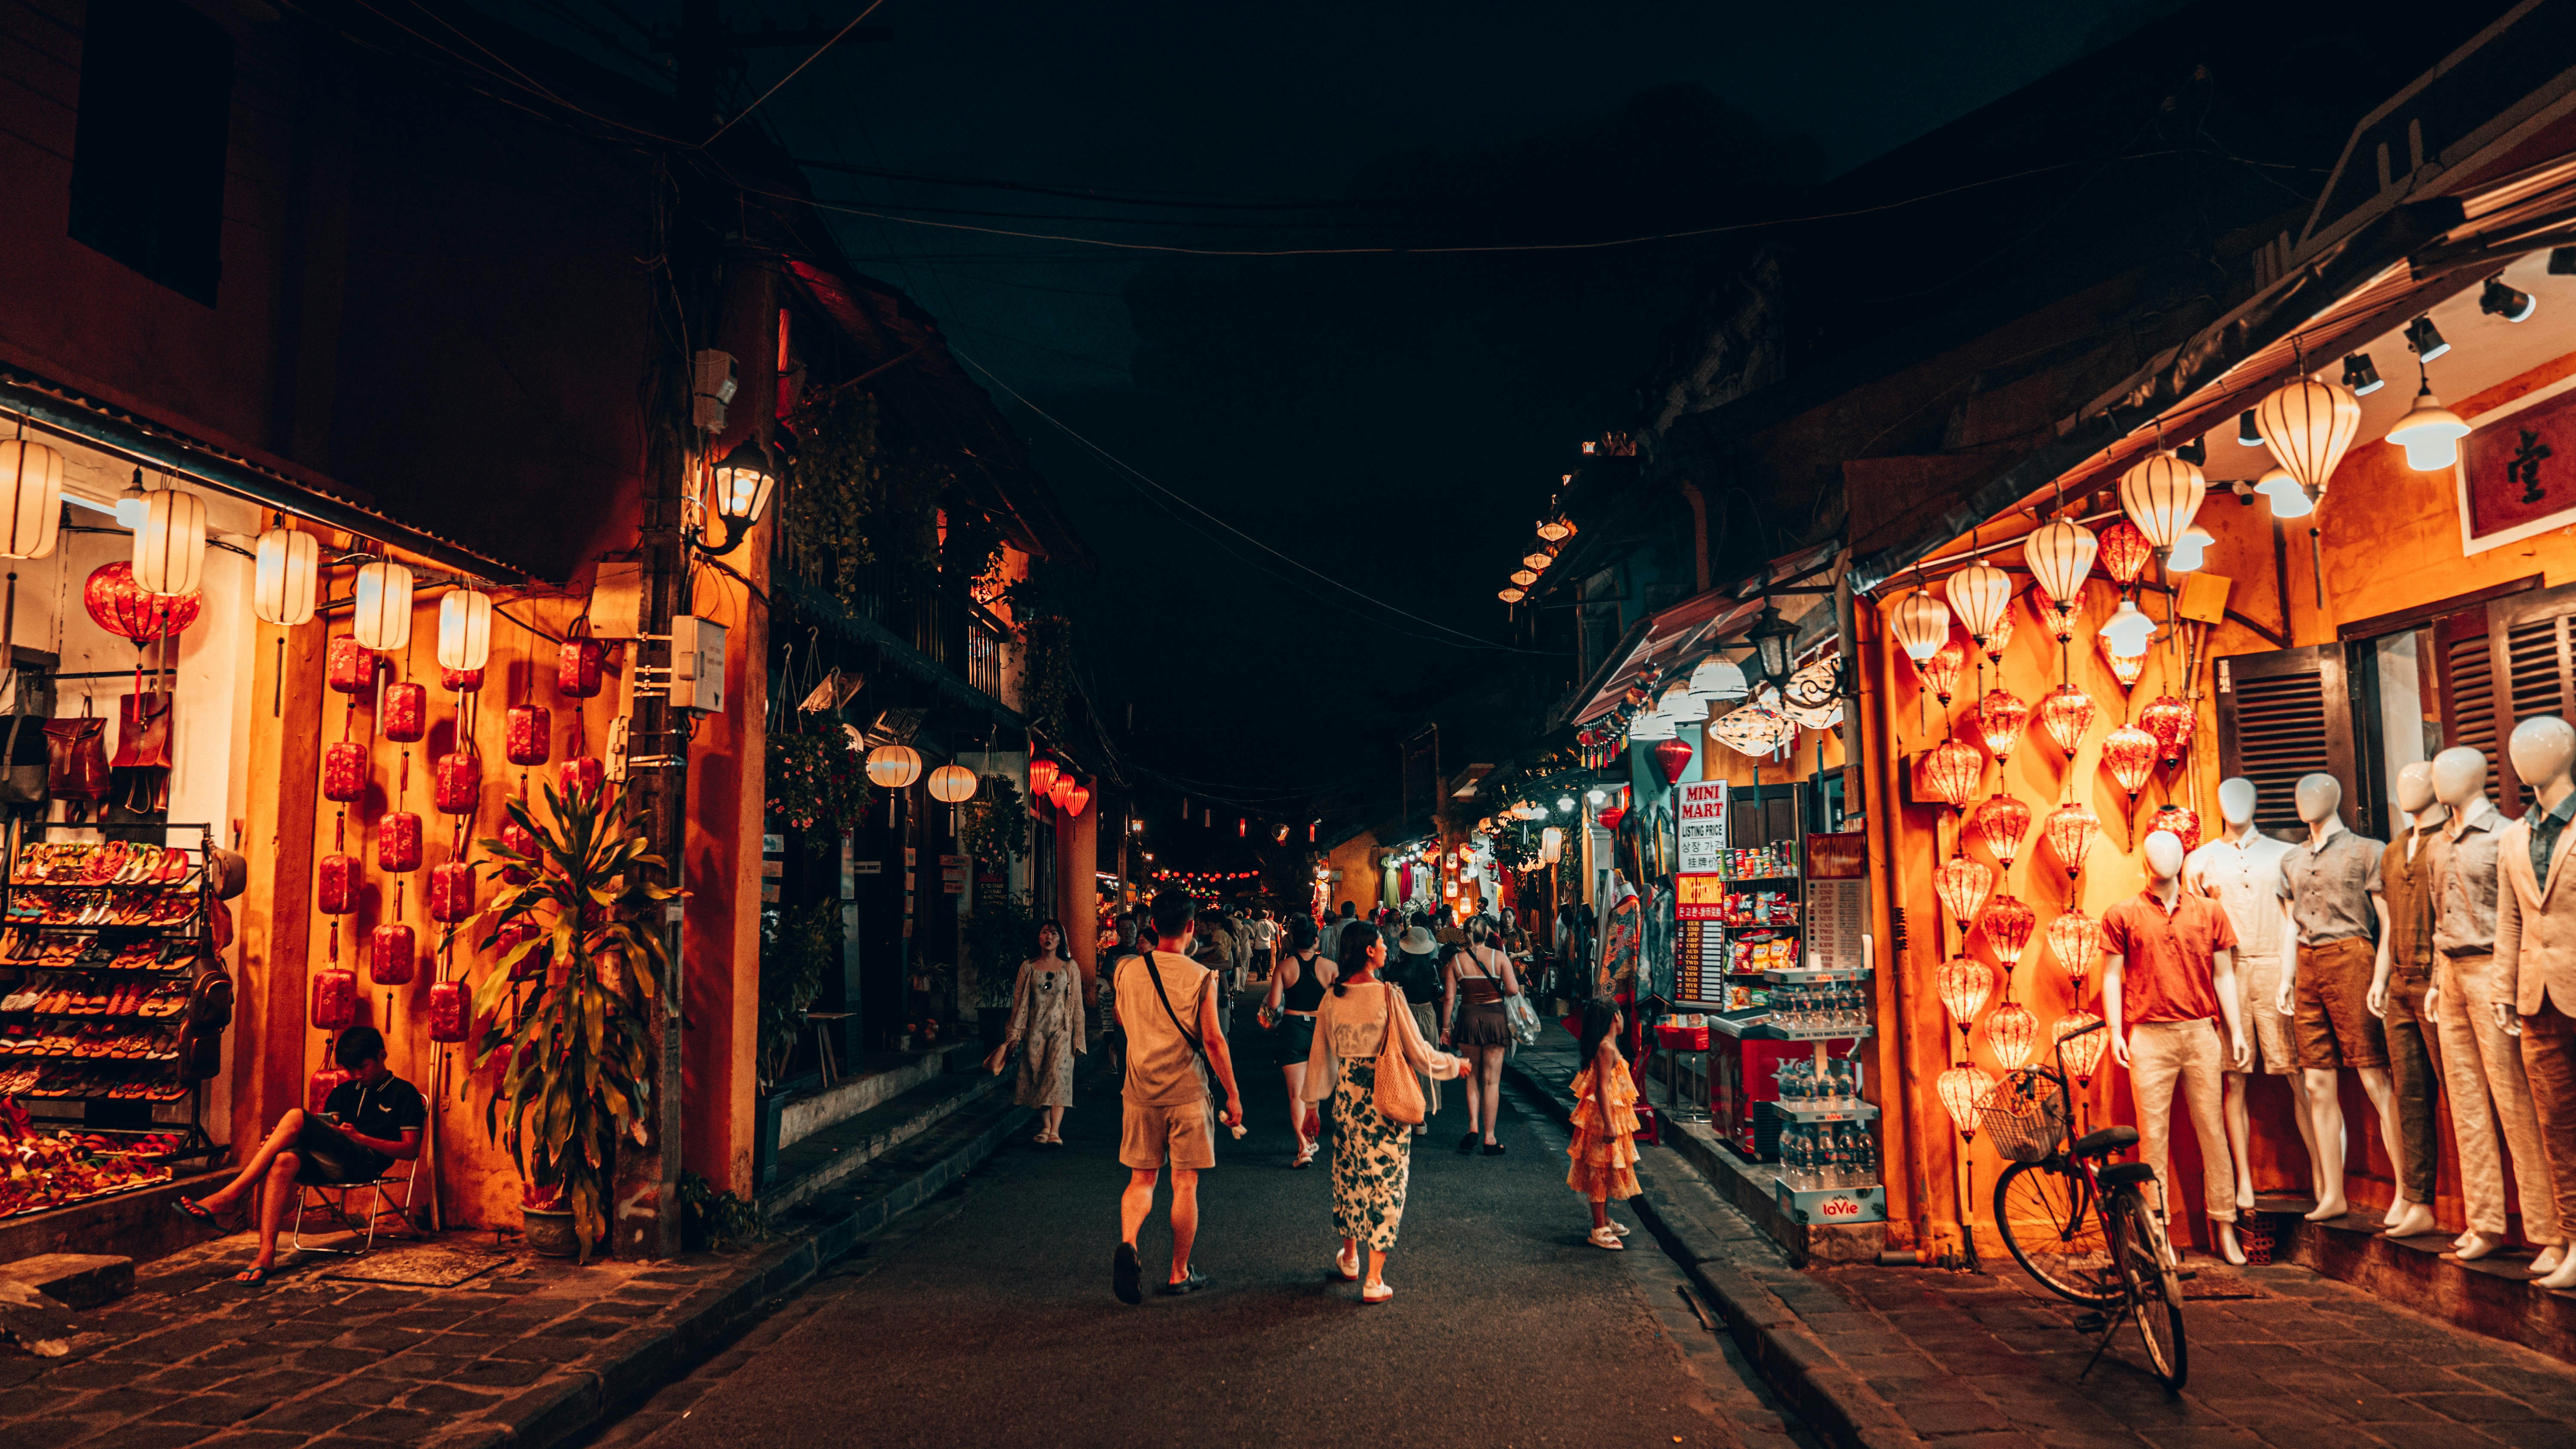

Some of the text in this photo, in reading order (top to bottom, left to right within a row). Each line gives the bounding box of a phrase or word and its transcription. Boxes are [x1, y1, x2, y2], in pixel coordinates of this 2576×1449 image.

[1687, 785, 1719, 801] MINI
[1682, 803, 1723, 819] MART
[1682, 824, 1722, 837] LISTING PRICE
[1823, 1201, 1858, 1215] laVie
